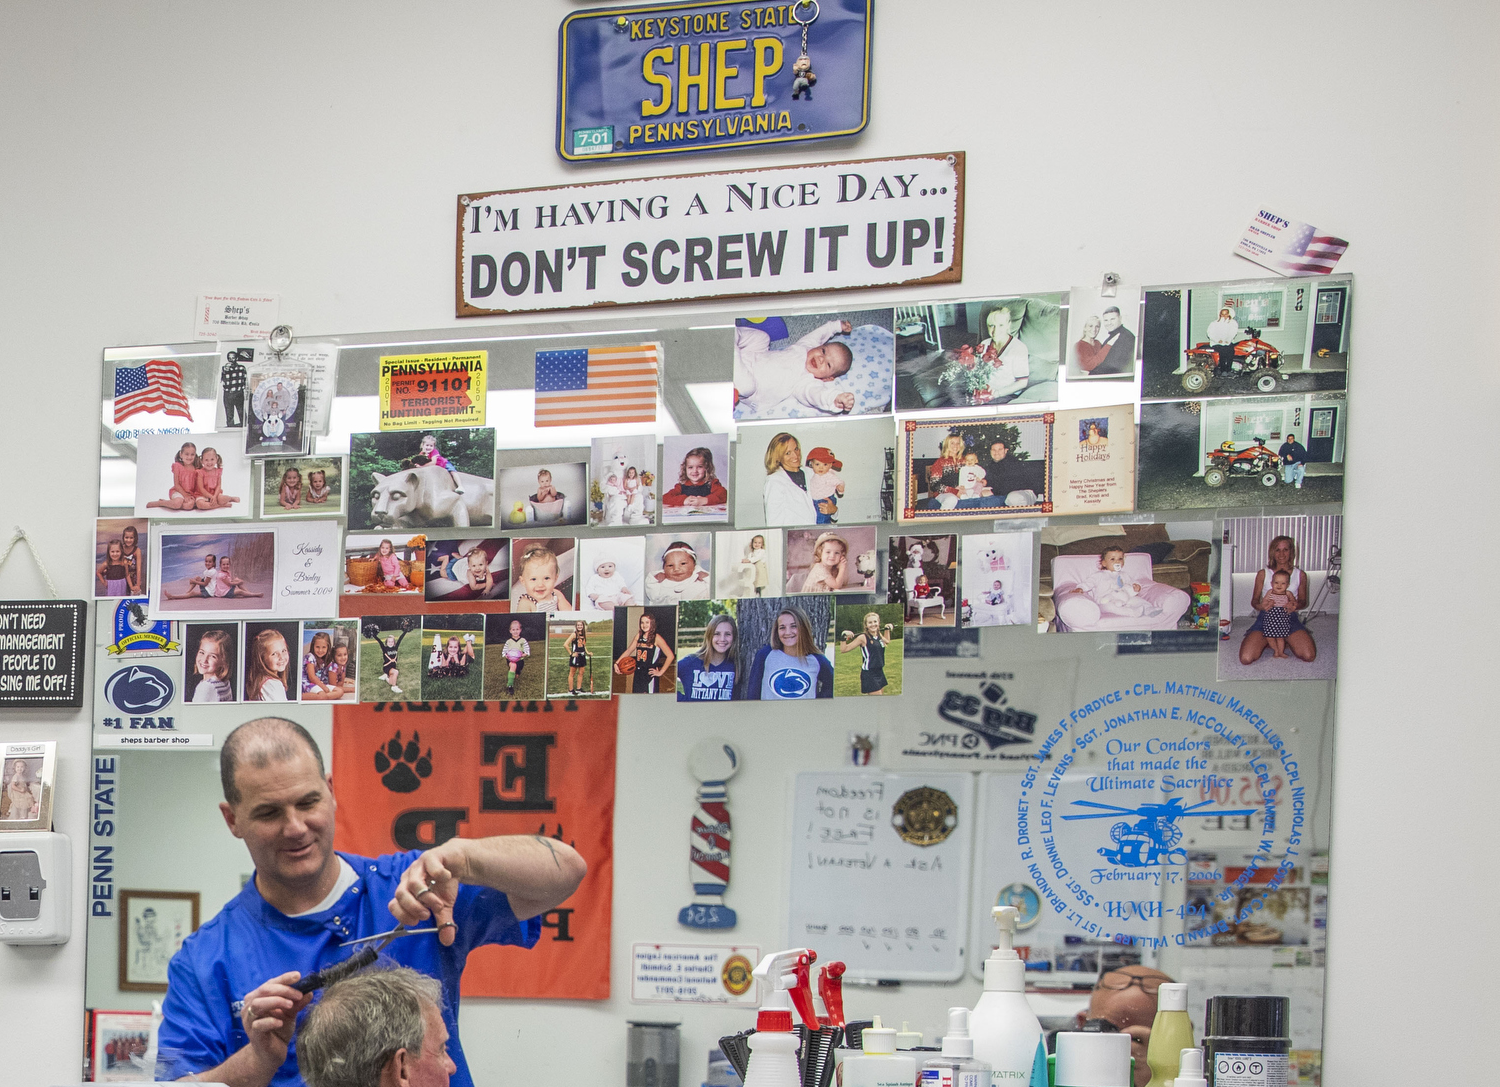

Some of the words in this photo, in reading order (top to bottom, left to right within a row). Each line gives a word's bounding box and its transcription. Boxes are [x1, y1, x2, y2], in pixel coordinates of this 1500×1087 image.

[631, 11, 730, 40] KEYSTONE
[743, 5, 798, 28] STATE
[641, 37, 784, 117] SHEP
[578, 132, 609, 145] 7-01
[629, 111, 792, 145] PENNSYLVANIA
[535, 195, 668, 229] HAVING
[1258, 209, 1290, 228] SHEP'S
[470, 245, 606, 299] DON'T
[620, 229, 788, 287] SCREW
[803, 224, 848, 273] IT
[866, 216, 945, 268] UP!
[382, 360, 482, 377] PENNSYLVANIA
[417, 377, 472, 393] 91101
[382, 408, 431, 419] HUNTING
[435, 406, 475, 416] PERMIT
[401, 396, 462, 407] TERRORIST
[1076, 452, 1110, 462] Holidays
[1081, 444, 1106, 453] Happy
[304, 558, 312, 567] &
[21, 613, 46, 629] NEED
[3, 654, 40, 670] PEOPLE
[42, 654, 56, 670] TO
[26, 675, 41, 691] ME
[43, 675, 67, 691] OFF!
[103, 718, 123, 729] #1
[130, 717, 174, 729] FAN
[1034, 728, 1063, 764] JAMES
[1059, 718, 1073, 731] F.
[1069, 690, 1122, 723] FORDYCE
[1104, 708, 1167, 732] JONATHAN
[1171, 707, 1182, 720] E.
[1165, 681, 1226, 705] MATTHIEU
[1226, 696, 1284, 751] MARCELLUS
[121, 737, 143, 745] sheps
[144, 736, 169, 744] barber
[171, 737, 190, 745] shop
[1106, 739, 1141, 755] Our
[1146, 737, 1210, 754] Condors
[1043, 753, 1074, 797] LEVENS
[1107, 757, 1134, 771] that
[1140, 756, 1180, 770] made
[1185, 756, 1207, 770] the
[1249, 756, 1270, 788] LCPL
[1280, 753, 1300, 786] LCPL
[1086, 776, 1155, 792] Ultimate
[1160, 774, 1234, 794] Sacrifice
[93, 758, 115, 837] STATE
[1018, 799, 1030, 845] DRONET
[1040, 810, 1052, 834] LEO
[1262, 788, 1276, 836] SAMUEL
[1289, 786, 1305, 845] NICHOLAS
[1021, 847, 1034, 860] R.
[1043, 835, 1069, 879] DONNIE
[92, 846, 113, 917] PENN
[1090, 868, 1161, 886] February
[1189, 869, 1222, 881] 2006
[1233, 854, 1267, 890] LARGE
[1027, 863, 1067, 913] BRANDON
[1188, 919, 1229, 942] BRYAN
